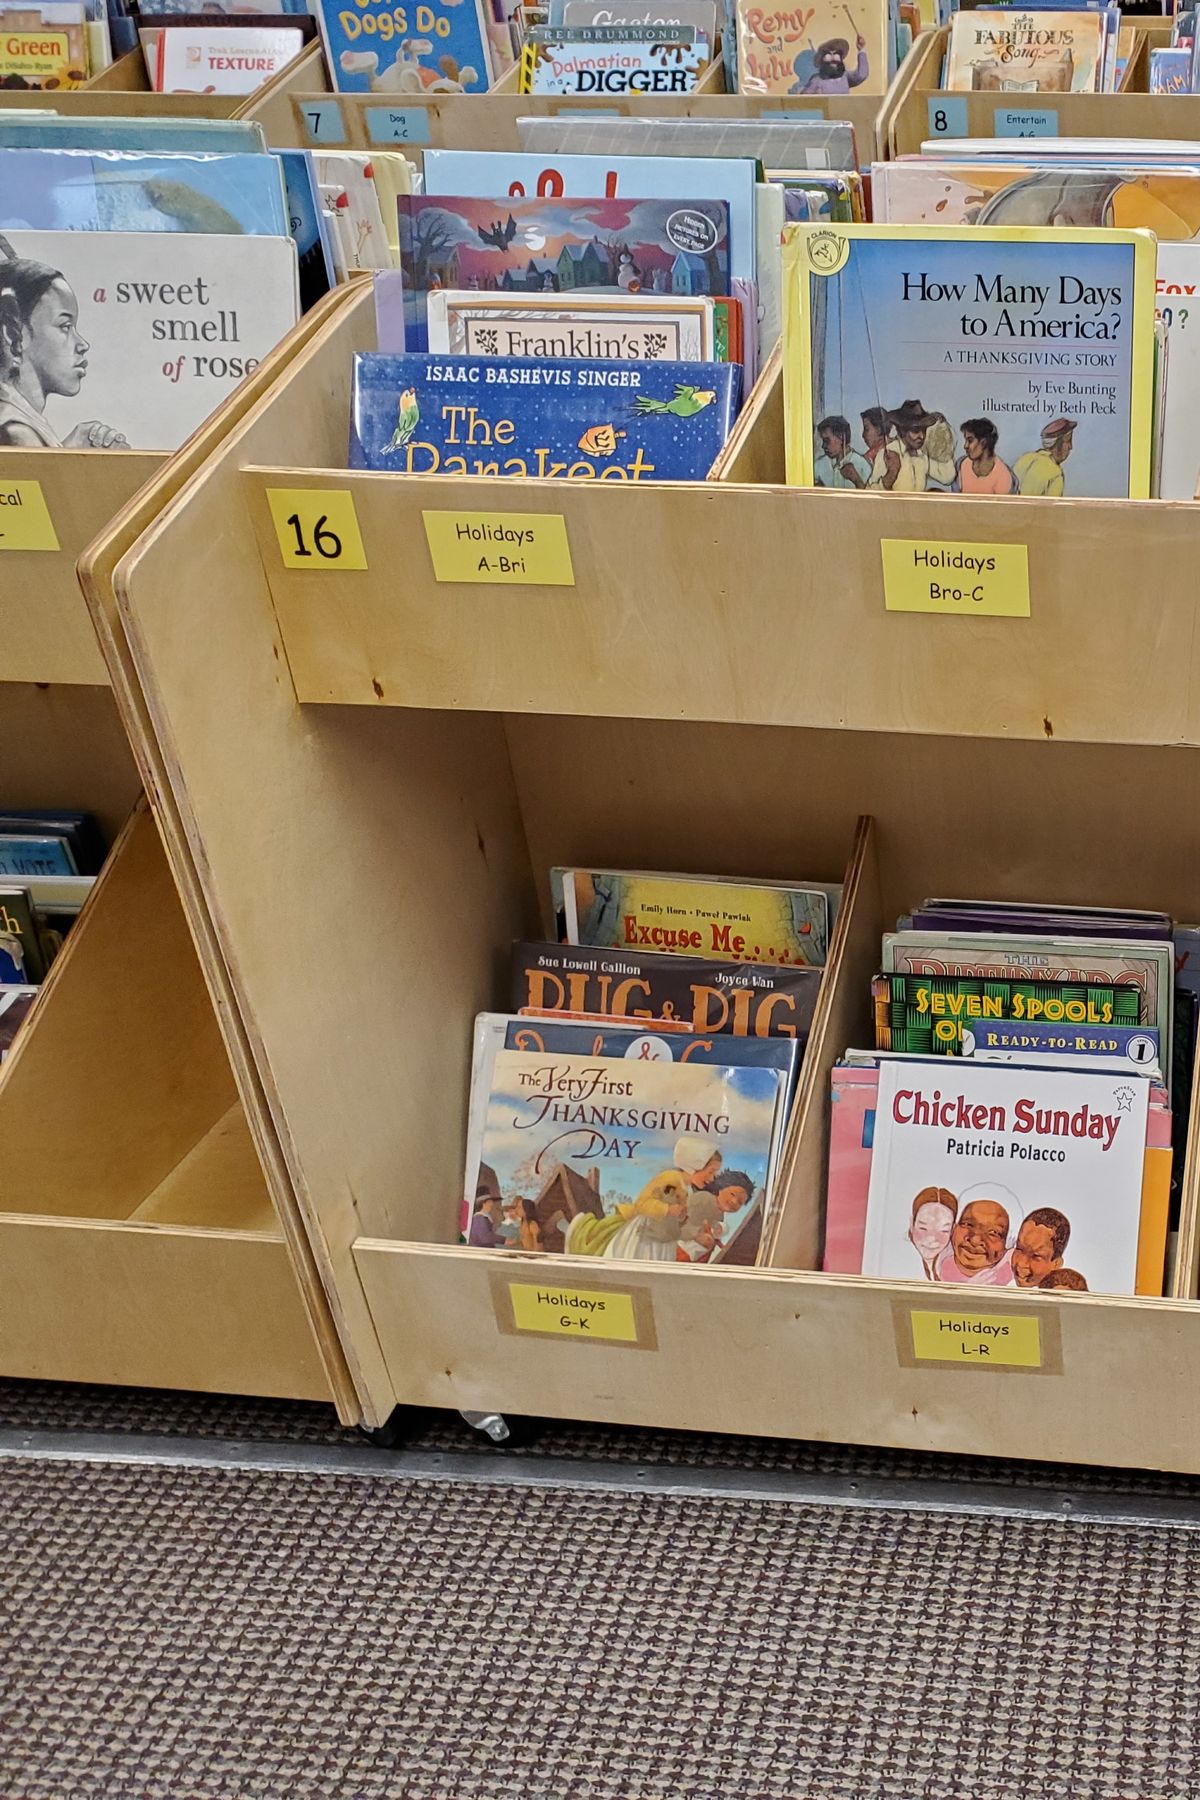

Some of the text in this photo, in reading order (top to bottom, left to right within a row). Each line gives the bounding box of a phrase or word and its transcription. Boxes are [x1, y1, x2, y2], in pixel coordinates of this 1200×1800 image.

[416, 6, 450, 37] Do
[746, 8, 815, 44] Remy
[544, 30, 680, 40] REE DRUMMOND
[767, 37, 783, 53] and
[6, 38, 61, 55] Green
[1000, 45, 1040, 68] Song
[208, 57, 274, 70] TEXTURE
[552, 53, 642, 78] Dalmatian
[575, 70, 687, 92] DIGGER
[308, 113, 321, 133] 7
[389, 114, 406, 126] Dog
[935, 110, 948, 131] 8
[1006, 114, 1047, 125] Entertain
[811, 229, 837, 239] CLARION
[93, 277, 210, 306] a sweet
[902, 271, 1121, 317] How Many Days
[152, 311, 240, 342] smell
[960, 308, 1121, 341] to America?
[505, 331, 640, 359] Franklin's
[162, 355, 186, 383] of
[944, 350, 1118, 368] A THANKSGIVING STORY
[425, 366, 642, 388] ISAAC BASHEVIS SINGER
[1028, 380, 1116, 399] by Eve Bunting
[982, 398, 1117, 415] illustrated by Beth Peck
[442, 406, 516, 445] The
[287, 514, 342, 559] 16
[456, 523, 535, 547] Holidays
[477, 556, 526, 574] A-Bri
[914, 549, 996, 575] Holidays
[930, 582, 984, 602] Bro-C
[640, 903, 664, 915] Emily
[667, 906, 687, 916] Horn
[623, 915, 702, 949] Excuse
[538, 955, 641, 976] Sue Lowell Gallion
[715, 971, 775, 989] Joyce Wan
[916, 987, 1114, 1024] SEVEN SPOOLS
[986, 1032, 1119, 1052] READY-TO-READ
[1135, 1043, 1146, 1061] 1
[518, 1066, 634, 1101] The Very First
[513, 1095, 731, 1135] THANKSGIVING
[892, 1089, 1121, 1152] Chicken Sunday
[535, 1129, 642, 1175] DAY
[946, 1138, 1067, 1163] Patricia Polacco
[537, 1291, 606, 1312] Holidays
[560, 1316, 590, 1330] G-K
[939, 1319, 1010, 1338] Holidays
[961, 1342, 991, 1356] L-R
